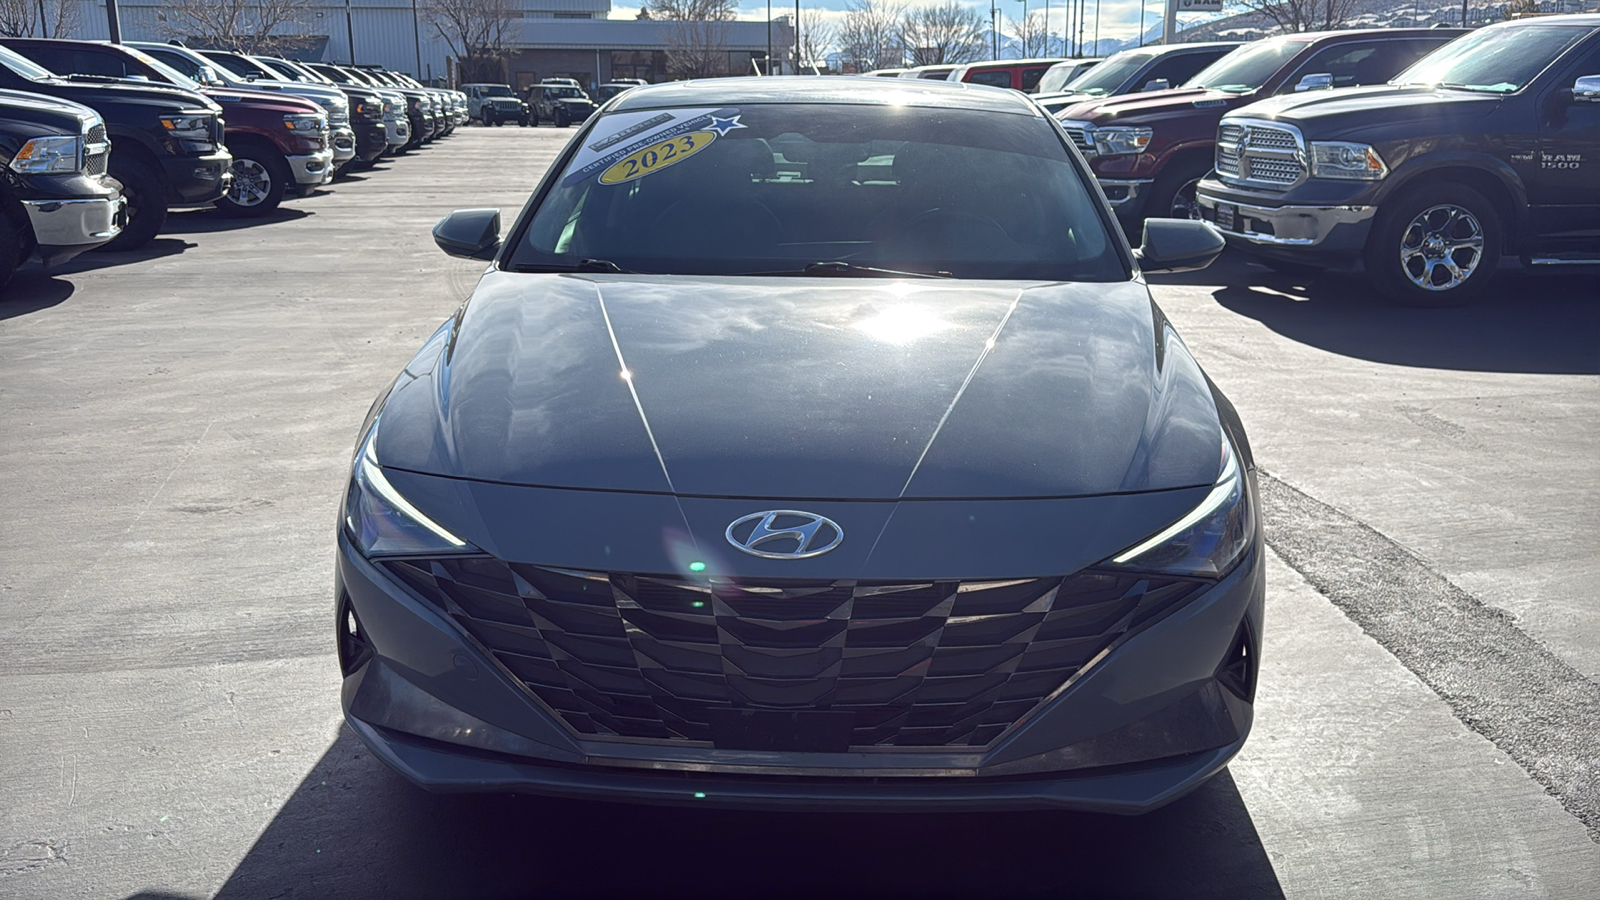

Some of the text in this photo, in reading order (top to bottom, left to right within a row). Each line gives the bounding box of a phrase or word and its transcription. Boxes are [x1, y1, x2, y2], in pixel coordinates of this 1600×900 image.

[582, 149, 626, 172] CERTIFIED
[627, 127, 677, 151] PRE-OWNED
[622, 135, 696, 179] 2023
